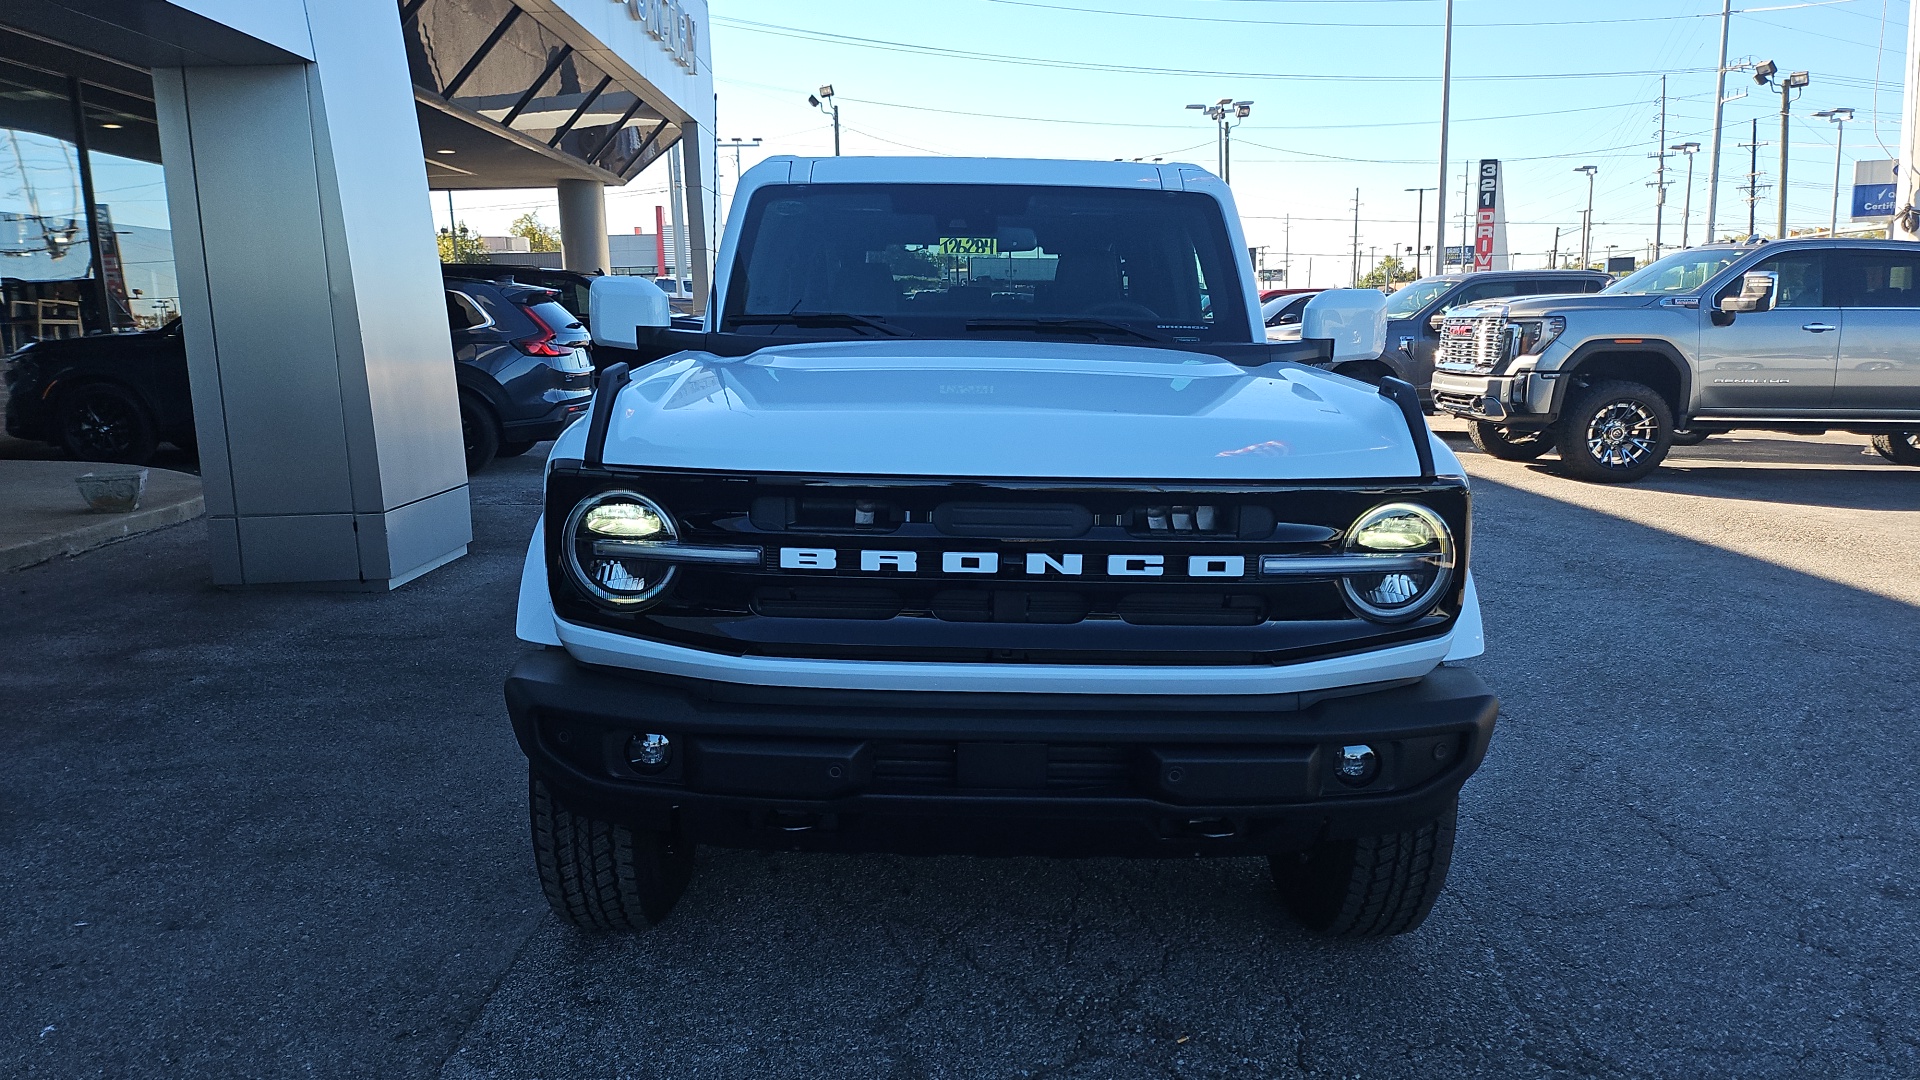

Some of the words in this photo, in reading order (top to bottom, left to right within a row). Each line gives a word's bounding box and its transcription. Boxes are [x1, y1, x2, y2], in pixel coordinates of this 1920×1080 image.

[1480, 163, 1496, 206] 321
[1864, 202, 1896, 211] Certifi
[780, 547, 1245, 578] BRONCO
